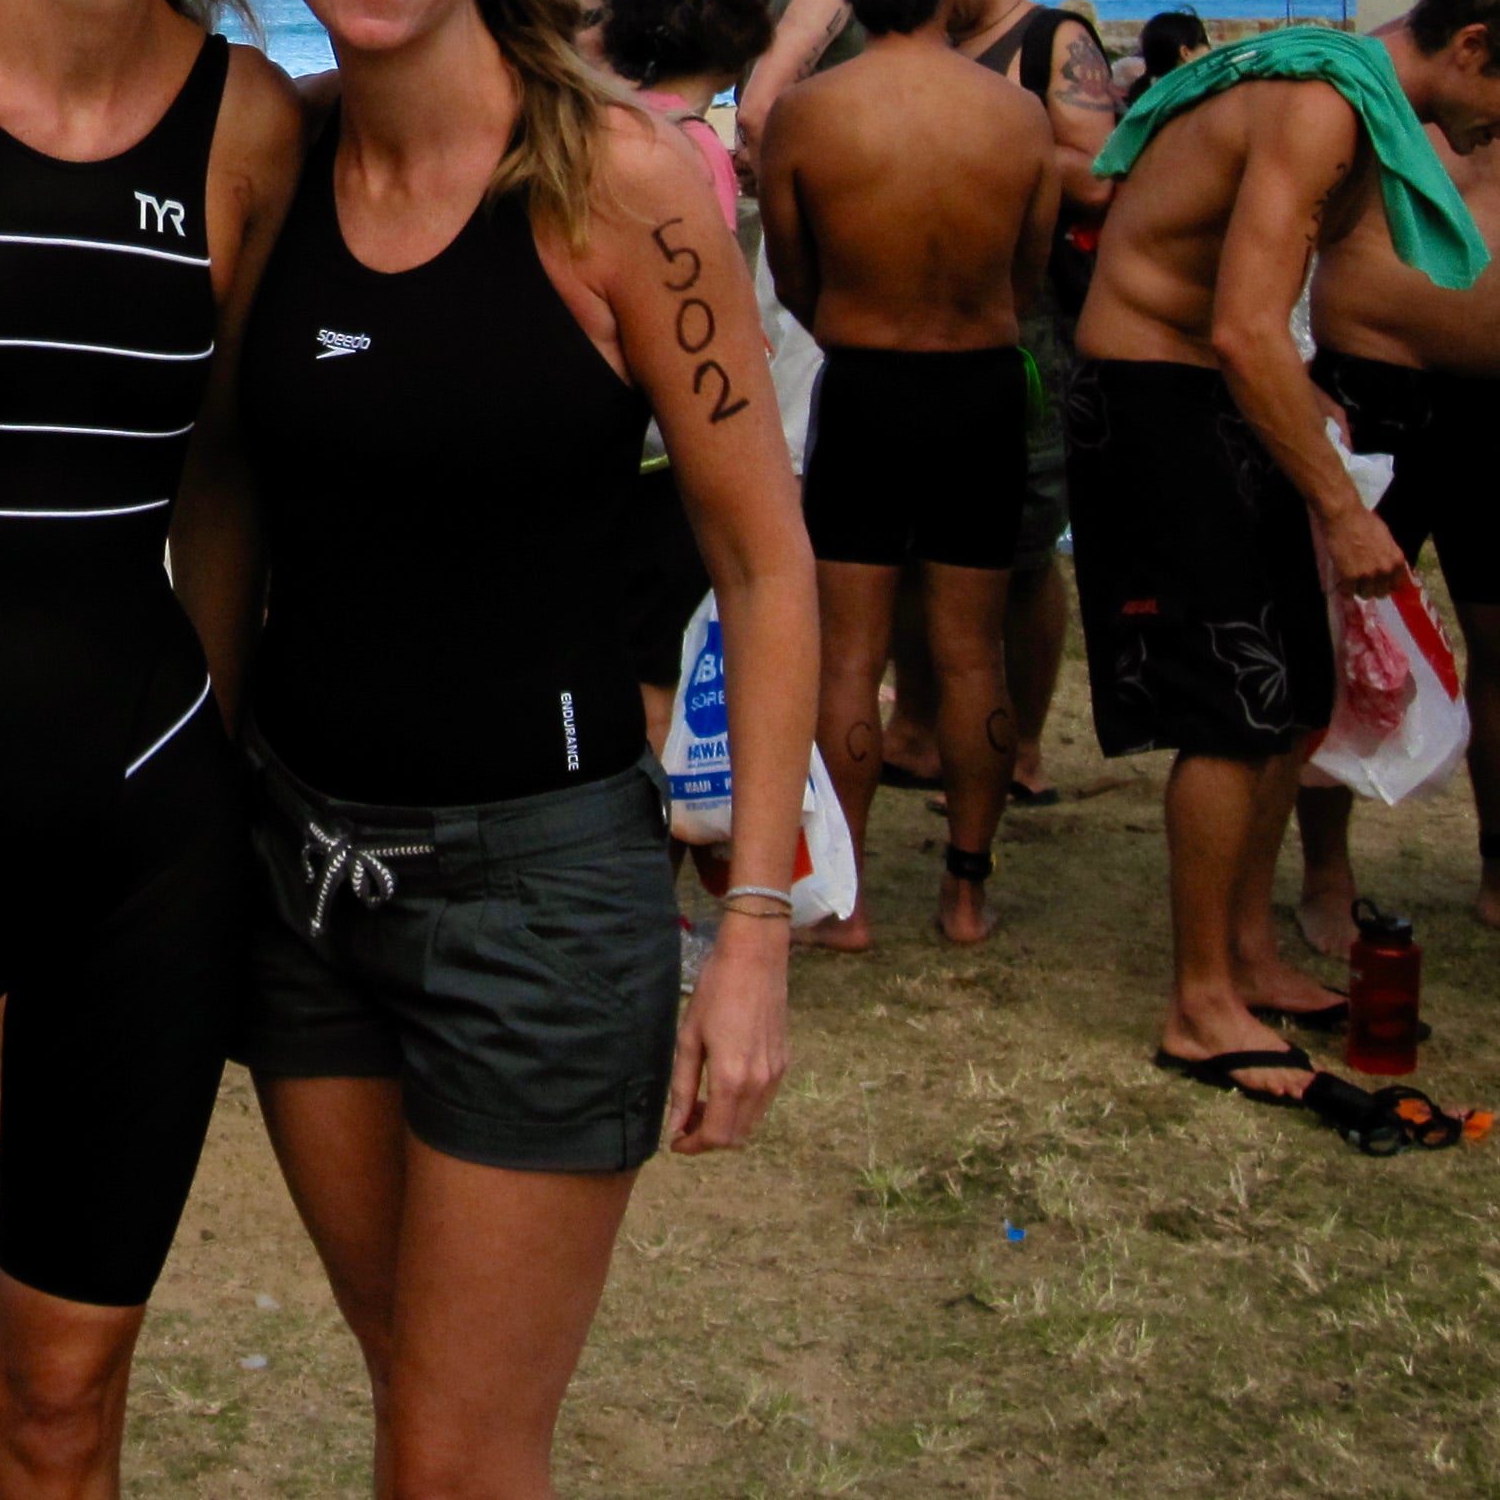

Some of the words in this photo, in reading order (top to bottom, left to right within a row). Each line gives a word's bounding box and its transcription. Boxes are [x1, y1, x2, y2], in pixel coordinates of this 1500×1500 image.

[134, 191, 186, 237] TYR
[316, 329, 372, 349] speedo
[651, 217, 749, 425] 502
[560, 692, 579, 771] ENDURANCE
